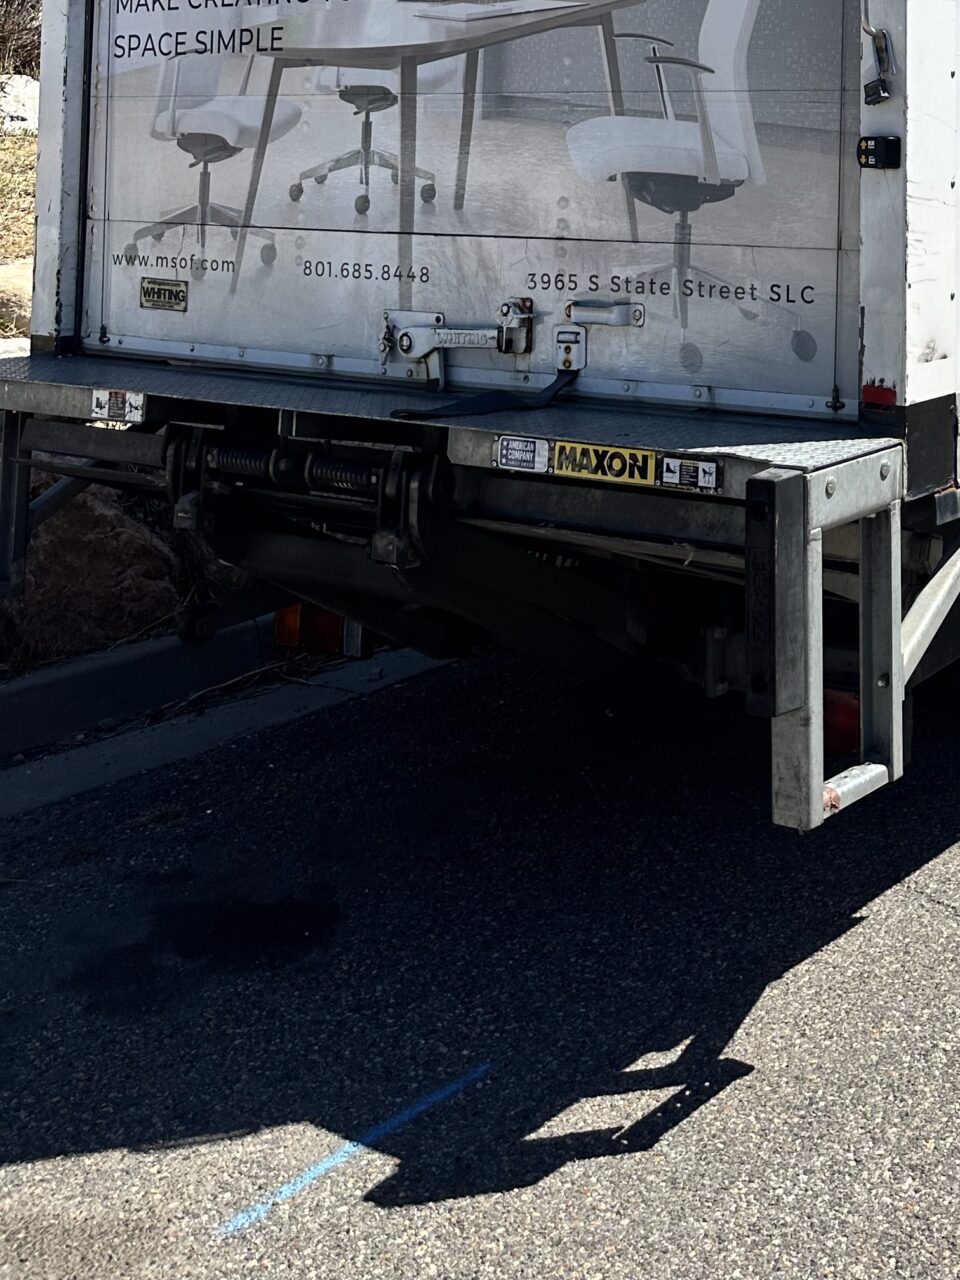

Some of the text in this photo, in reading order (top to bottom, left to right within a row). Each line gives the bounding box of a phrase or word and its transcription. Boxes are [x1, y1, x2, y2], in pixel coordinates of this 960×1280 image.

[113, 26, 284, 59] SPACE SIMPLE
[112, 252, 235, 274] www.msof.com
[303, 259, 431, 284] 801.685.8448
[142, 286, 186, 302] WHITING
[527, 272, 816, 305] 3965 S State Street SLC
[507, 449, 533, 462] COMPANY
[508, 439, 535, 451] AMERICAN
[556, 445, 649, 480] MAXON
